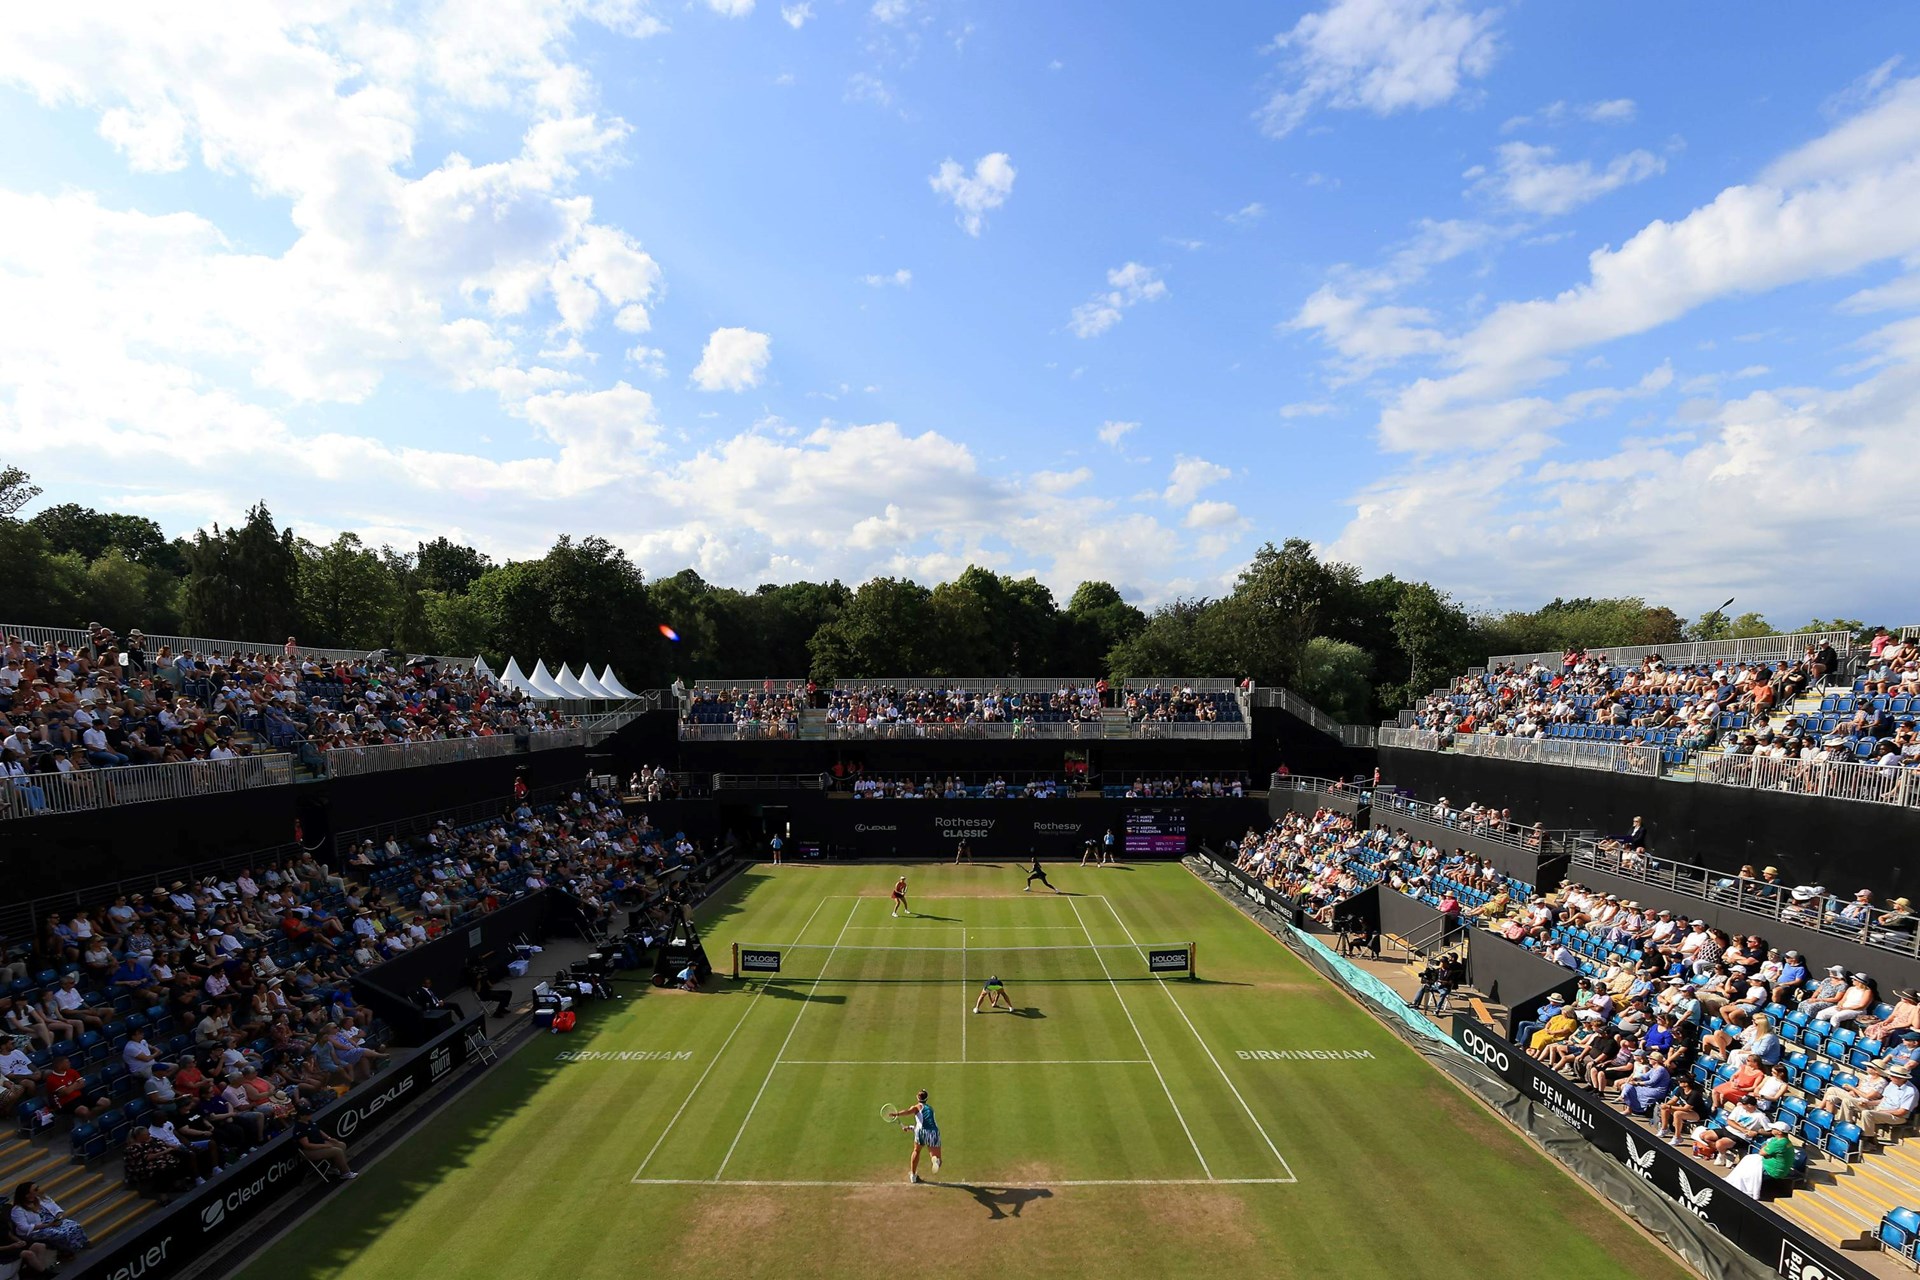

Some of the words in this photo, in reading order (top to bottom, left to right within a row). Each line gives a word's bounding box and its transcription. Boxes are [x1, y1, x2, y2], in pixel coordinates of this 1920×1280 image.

[935, 817, 995, 829] Rothesay
[1033, 822, 1081, 832] Rothesay
[943, 829, 988, 838] CLASSIC
[744, 954, 778, 963] HOLOGIC
[1152, 954, 1186, 963] HOLOGIC
[1236, 1050, 1376, 1060] BIRMINGHAM
[1463, 1028, 1509, 1072] oppo
[554, 1051, 693, 1061] BIRMINGHAM
[430, 1051, 451, 1077] YOUTH
[360, 1075, 414, 1120] LEXUS
[1543, 1099, 1552, 1109] ST
[1551, 1105, 1581, 1130] ANDREWS
[226, 1176, 265, 1211] Clear
